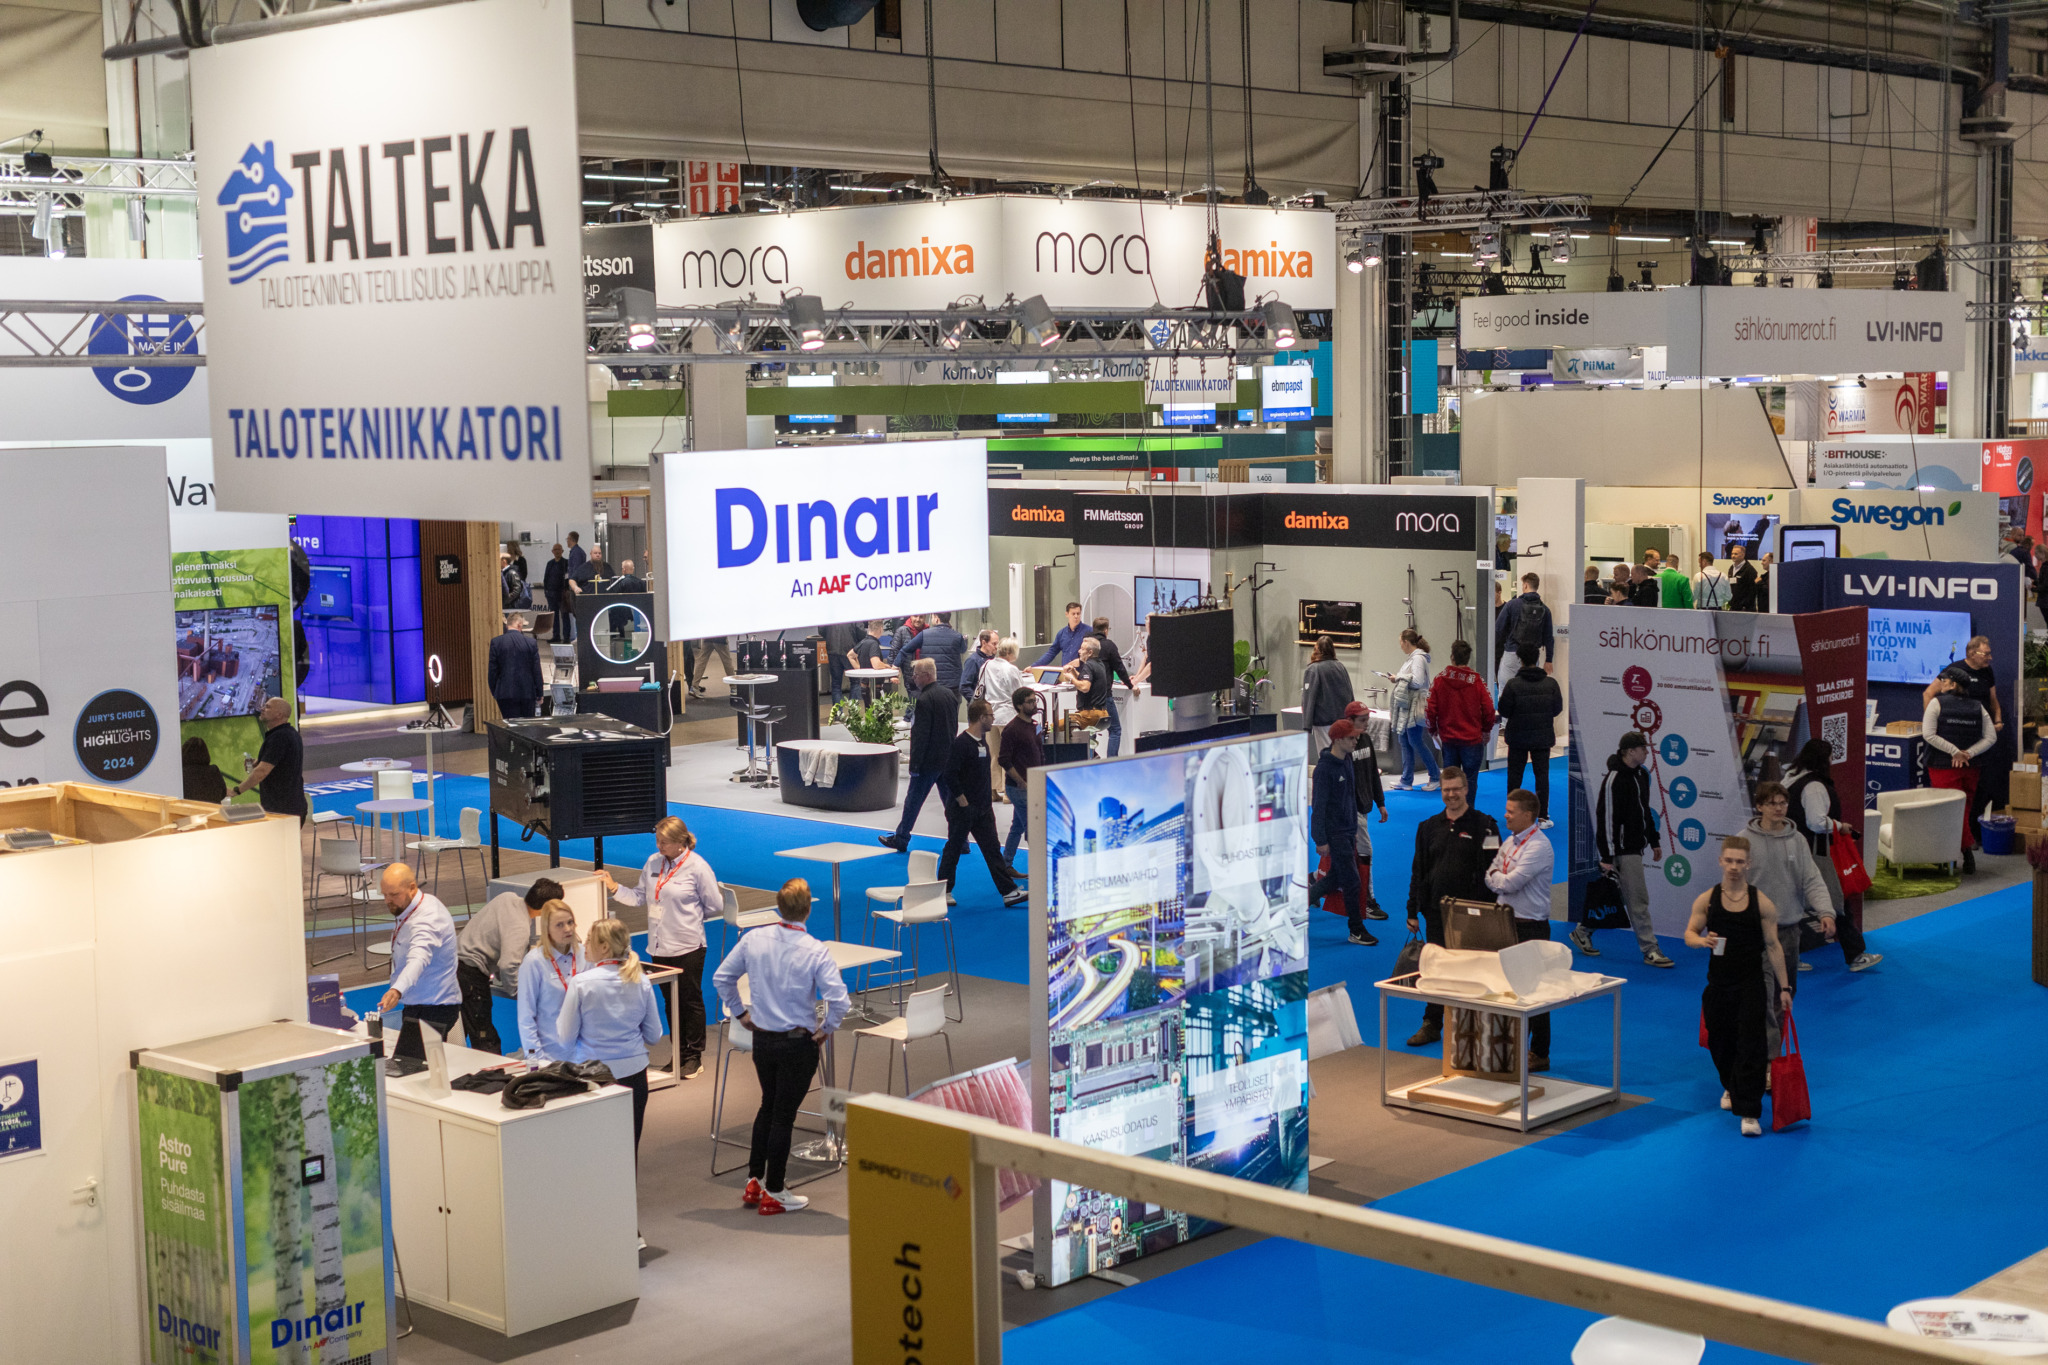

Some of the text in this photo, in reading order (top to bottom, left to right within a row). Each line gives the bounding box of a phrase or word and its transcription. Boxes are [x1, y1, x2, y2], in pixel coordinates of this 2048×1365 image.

[290, 125, 547, 263] TALTEKA
[844, 236, 975, 281] damixa
[1036, 231, 1150, 276] mora
[682, 245, 789, 290] mora
[259, 269, 363, 310] TALOTEKNINEN
[365, 266, 457, 305] TEOLLISUUS
[461, 265, 480, 299] JA
[482, 260, 557, 297] KAUPPA
[1473, 308, 1589, 333] Feel good inside
[1734, 315, 1837, 342] sähkönumerot.fi
[1582, 360, 1615, 372] PiiMat
[1150, 379, 1231, 393] TALOTEKNIIKKATORI
[1271, 379, 1303, 394] ebmpapst
[1838, 409, 1866, 423] WARMIA
[229, 405, 562, 462] TALOTEKNIIKKATORI
[1069, 455, 1089, 463] always
[1102, 454, 1115, 462] best
[1828, 449, 1882, 459] BITHOUSE
[1712, 493, 1766, 508] Swegon
[1011, 505, 1065, 522] damixa
[1284, 511, 1349, 530] damixa
[1396, 512, 1459, 533] mora
[1831, 497, 1945, 531] Swegon
[715, 487, 939, 569] Dinair
[175, 561, 237, 573] pienemmäksi
[213, 573, 254, 583] nousuun
[790, 570, 933, 598] An AAF Company
[1843, 574, 1998, 601] LVI-INFO
[1867, 617, 1933, 635] ITÄ MINÄ
[1599, 626, 1771, 659] sähkönumerot.fi
[1811, 633, 1861, 653] sähkönumerot.fi
[1816, 680, 1836, 693] TILAA
[87, 709, 146, 723] JURY'S CHOICE
[83, 730, 151, 748] HIGHLIGHTS
[103, 756, 135, 770] 2024
[1221, 846, 1273, 865] PUHDASTILAT
[1077, 867, 1159, 892] YLEISILMANVAIHTO
[1229, 1073, 1269, 1093] TEOLLISET
[1082, 1115, 1158, 1147] KAASUSUODATUS
[158, 1132, 192, 1158] Astro
[159, 1151, 188, 1175] Pure
[160, 1177, 205, 1204] Puhdasta
[161, 1196, 206, 1222] sisäilmaa
[158, 1303, 221, 1351] Dinair
[271, 1300, 365, 1350] Dinair
[328, 1329, 363, 1345] Company
